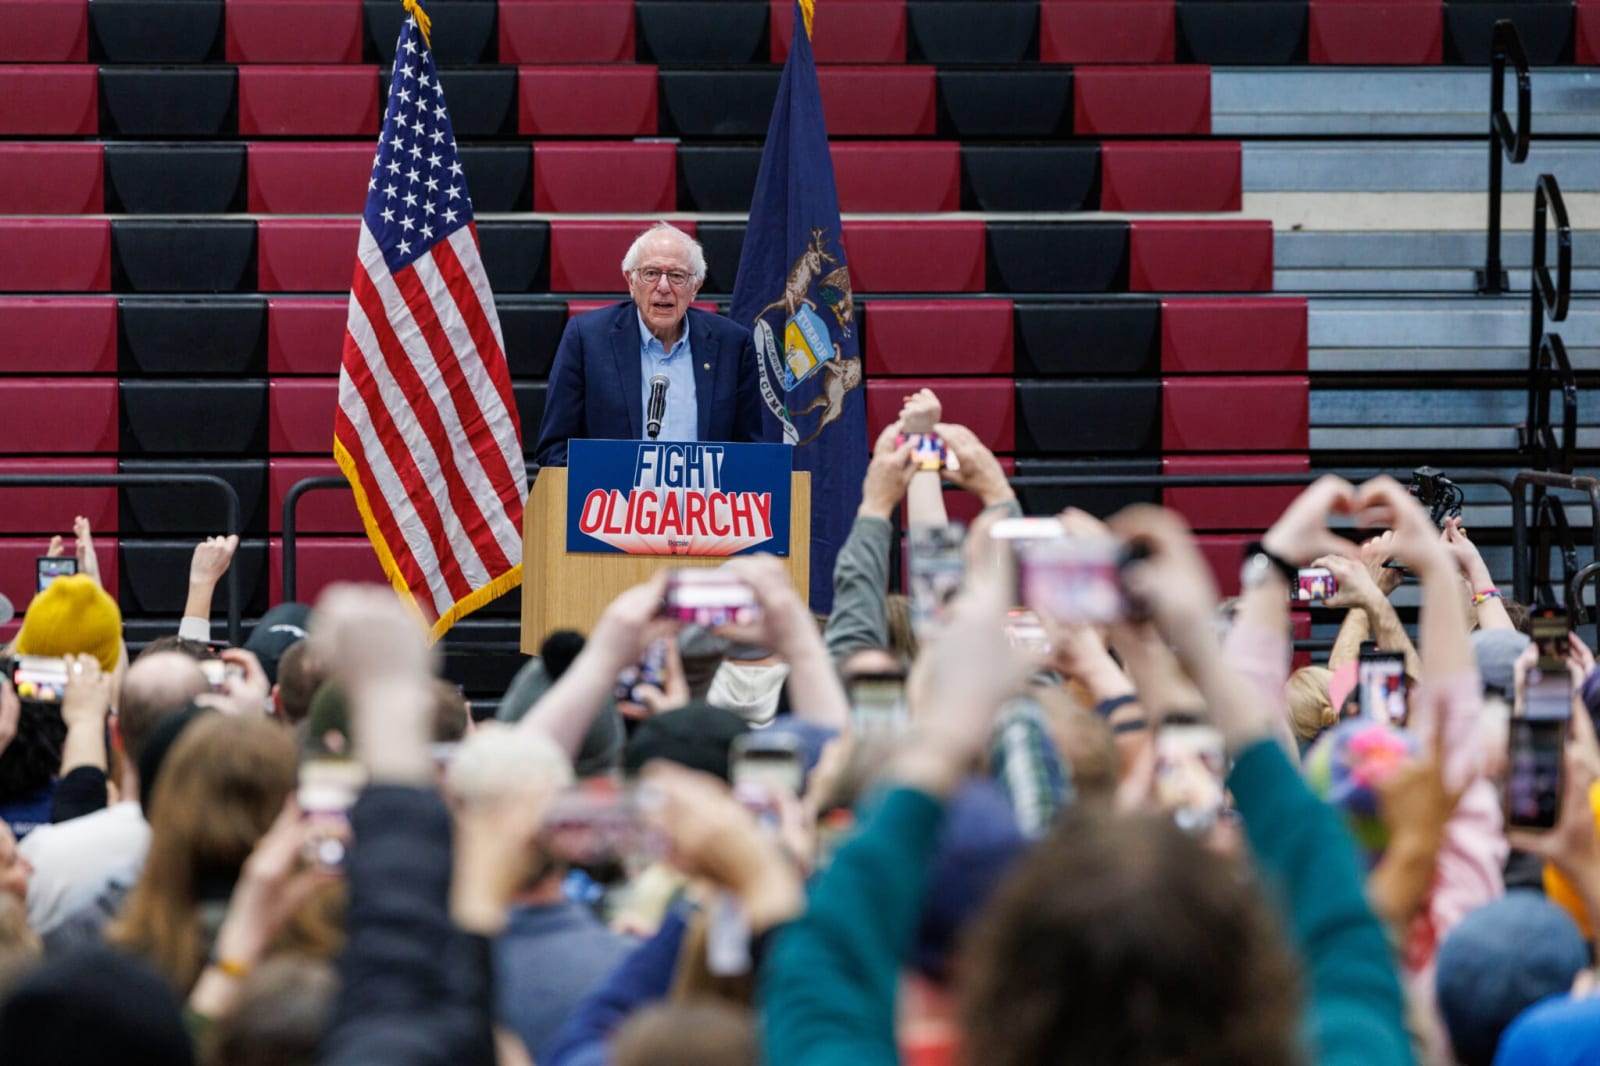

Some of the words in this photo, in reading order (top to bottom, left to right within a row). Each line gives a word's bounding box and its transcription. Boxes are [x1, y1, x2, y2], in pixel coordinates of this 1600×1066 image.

[797, 311, 829, 359] TUEBOR
[633, 444, 725, 489] FIGHT
[579, 488, 773, 538] OLIGARCHY
